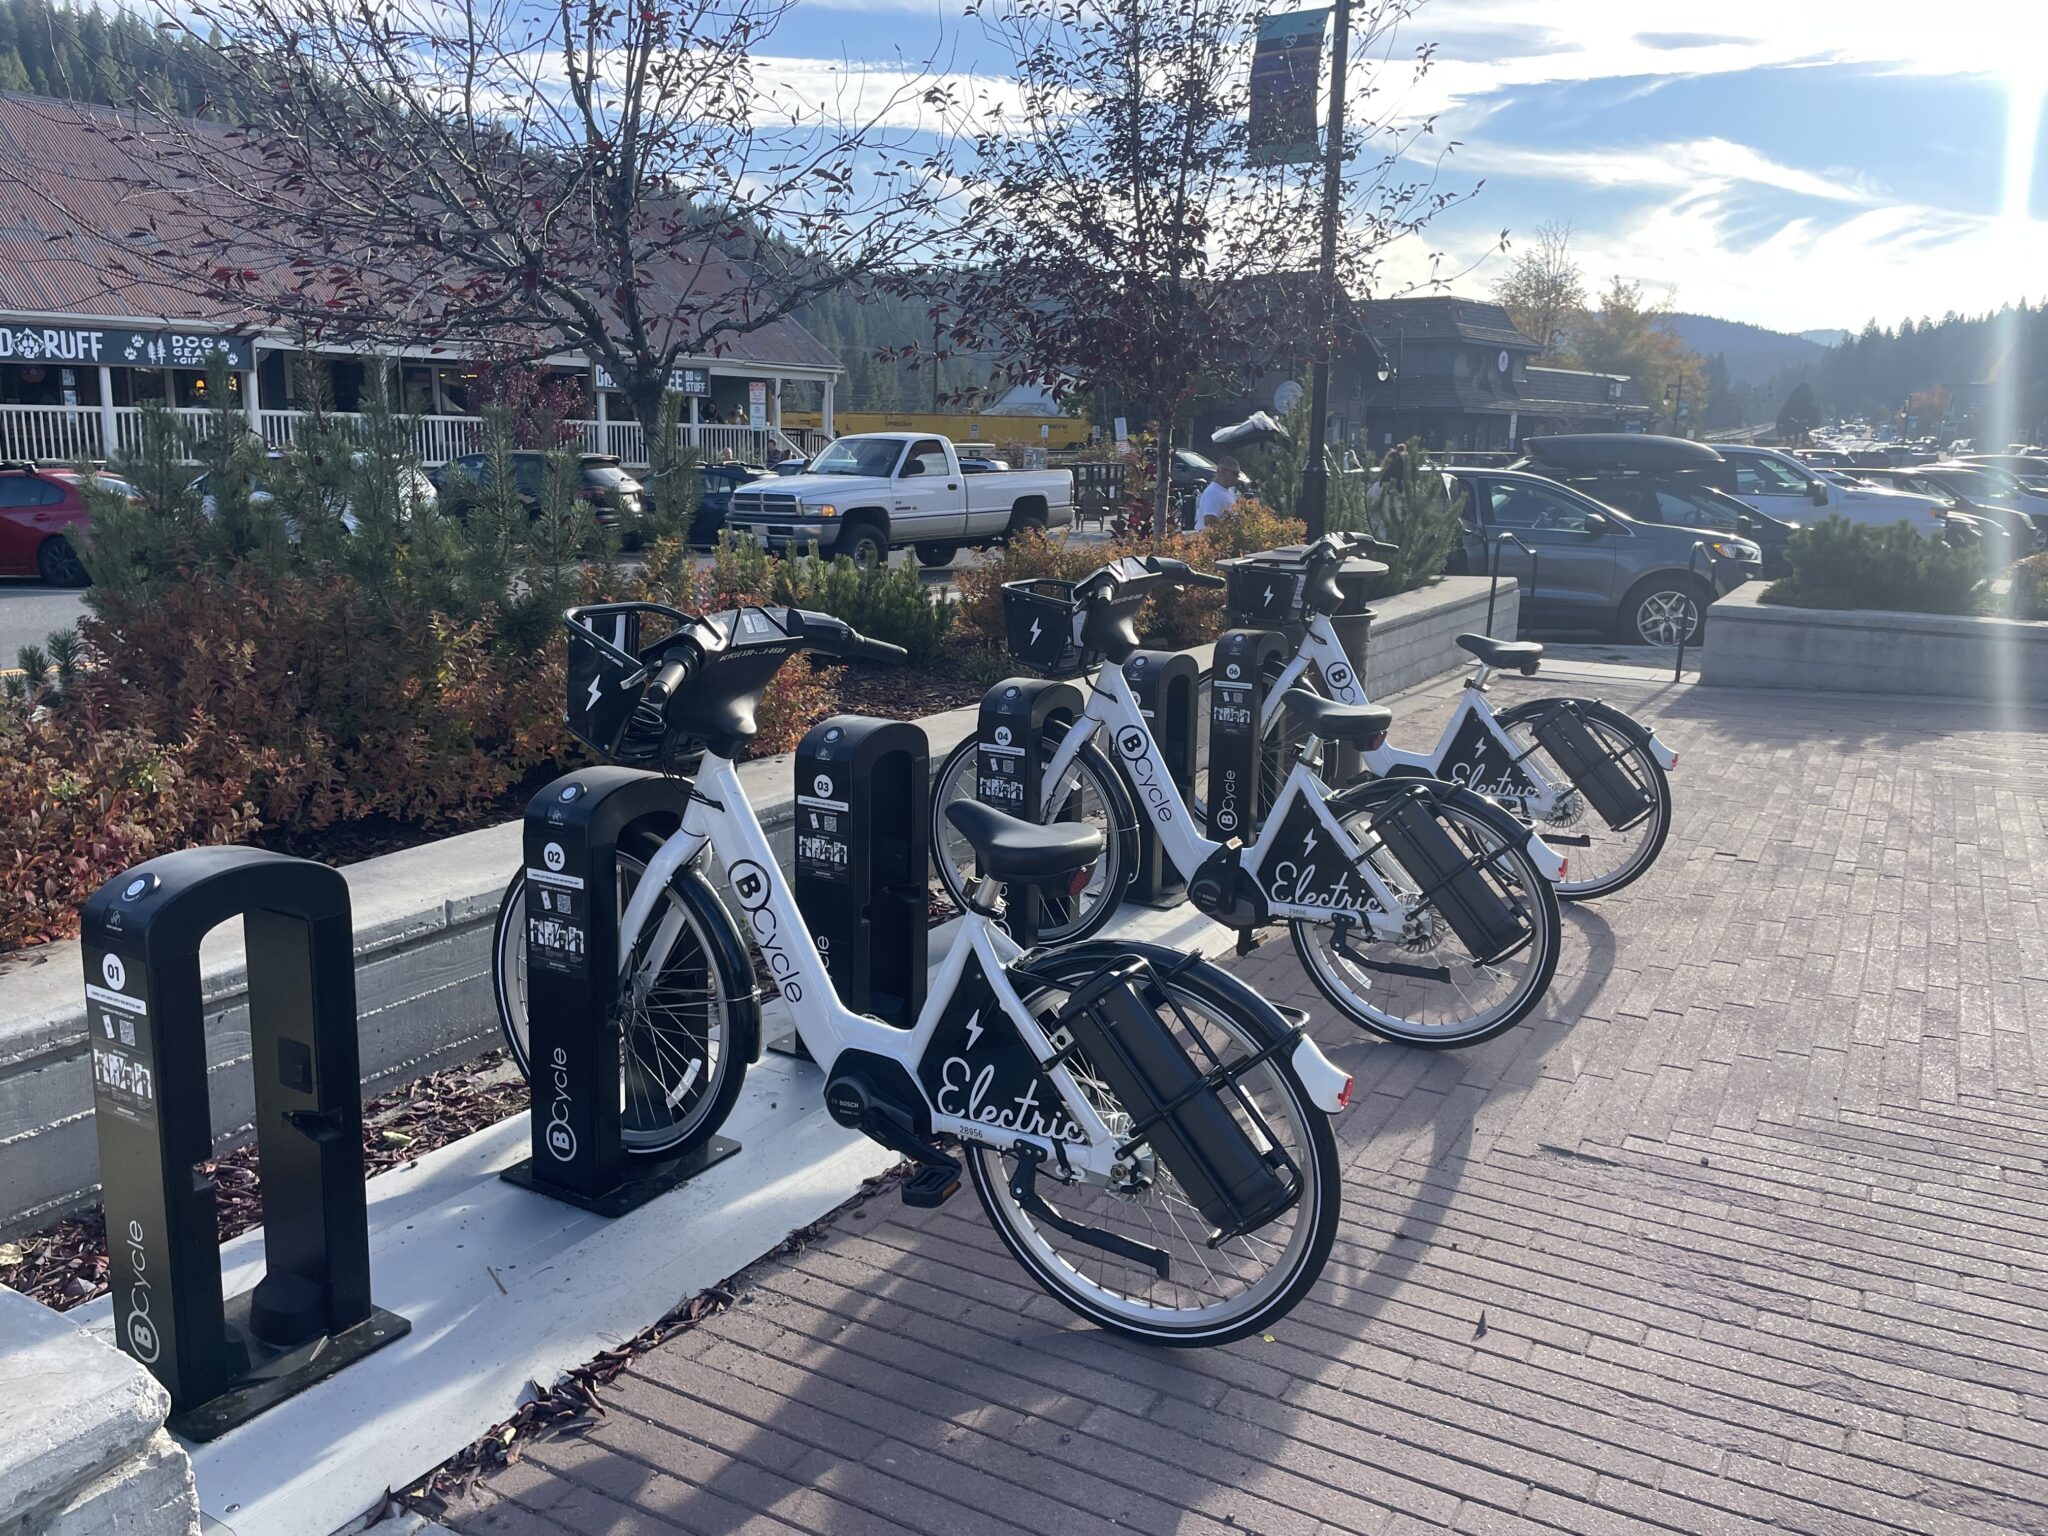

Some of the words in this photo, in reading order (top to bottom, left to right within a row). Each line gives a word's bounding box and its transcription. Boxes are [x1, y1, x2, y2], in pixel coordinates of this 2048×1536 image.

[43, 328, 103, 362] RUFF
[172, 335, 214, 348] DOG
[685, 381, 706, 392] STUFF
[997, 732, 1008, 741] 04
[817, 781, 829, 792] 03
[1450, 763, 1539, 797] Electric
[547, 850, 561, 864] 02
[1271, 861, 1382, 912] Electric
[107, 963, 119, 981] 01
[839, 1099, 859, 1109] BOSCH
[938, 1056, 1086, 1143] Electric
[959, 1124, 983, 1138] 28956
